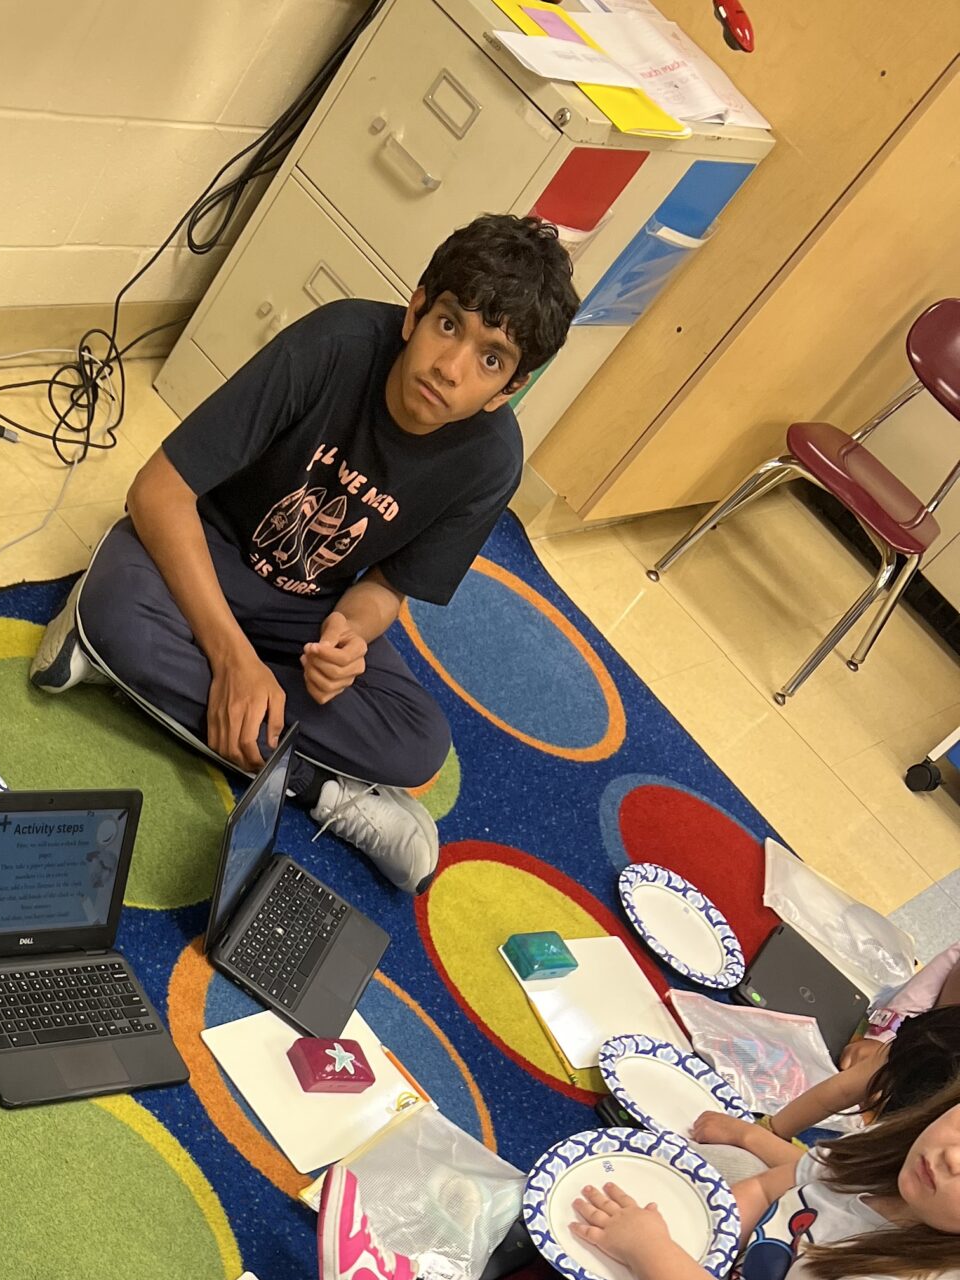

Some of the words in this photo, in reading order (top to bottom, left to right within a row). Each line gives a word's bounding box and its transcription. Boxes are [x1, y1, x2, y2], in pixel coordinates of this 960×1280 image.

[338, 460, 368, 495] WE
[360, 486, 400, 522] NEED
[14, 823, 54, 836] Activity
[57, 822, 85, 834] steps
